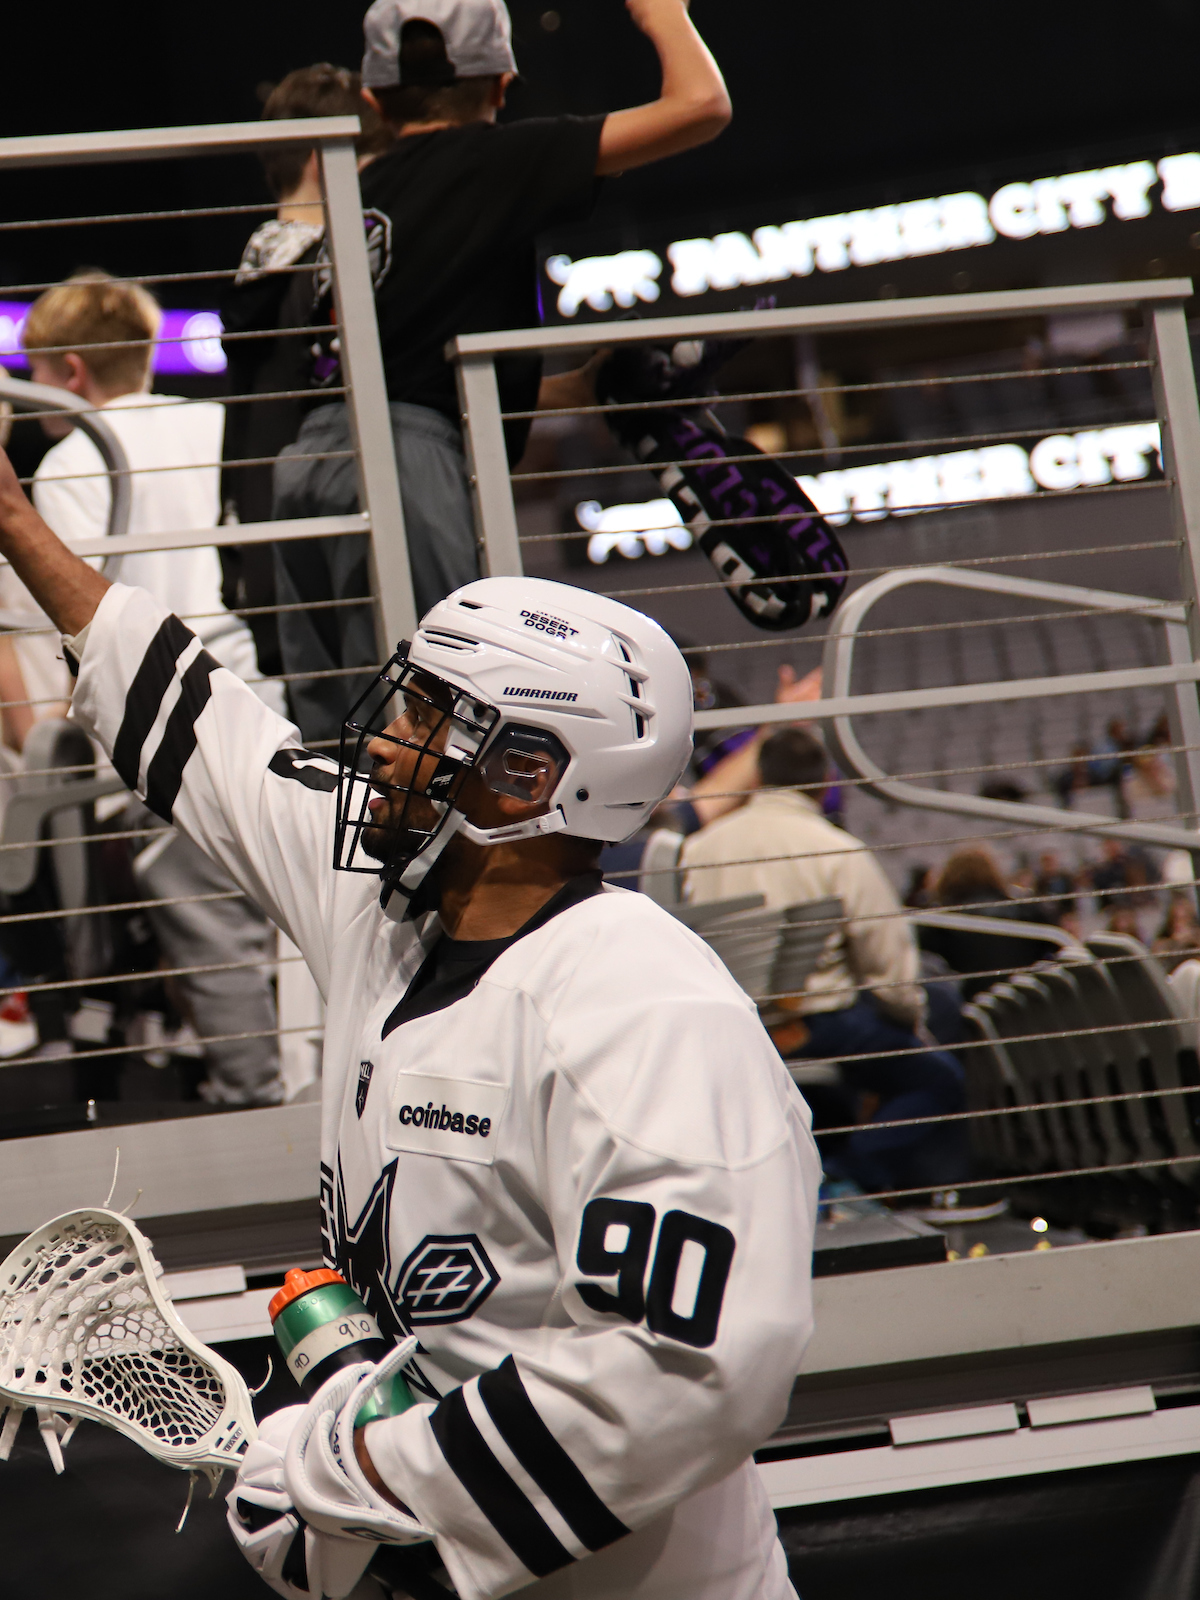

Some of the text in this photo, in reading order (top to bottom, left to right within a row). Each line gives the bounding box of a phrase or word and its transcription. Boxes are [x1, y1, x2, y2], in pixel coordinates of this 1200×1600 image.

[988, 159, 1158, 240] CITY
[1029, 422, 1165, 491] CIT
[519, 609, 580, 636] DESERT
[524, 619, 567, 640] DOGS
[502, 686, 579, 702] WARRIOR
[399, 1101, 492, 1138] coinbase
[575, 1197, 736, 1349] 90
